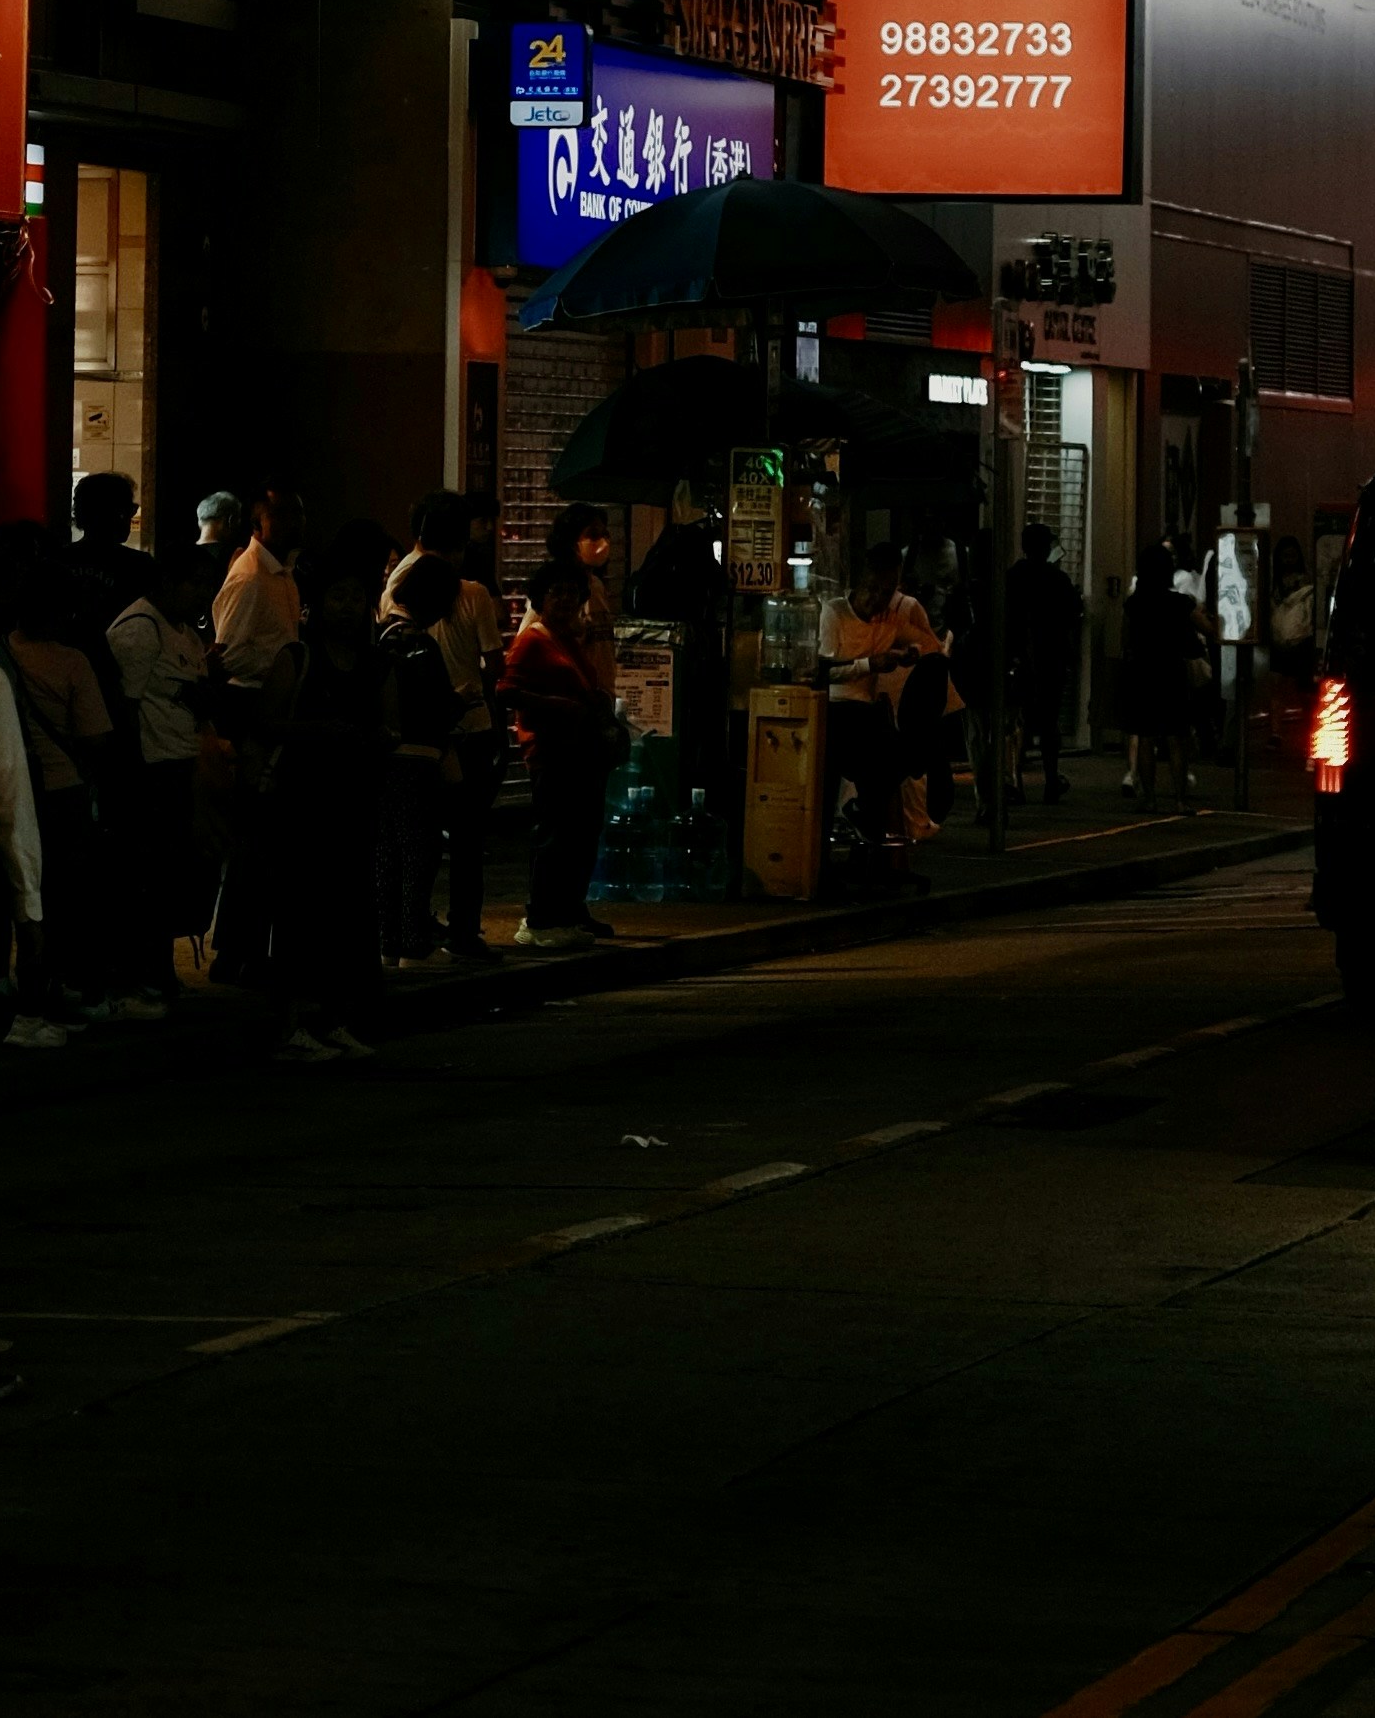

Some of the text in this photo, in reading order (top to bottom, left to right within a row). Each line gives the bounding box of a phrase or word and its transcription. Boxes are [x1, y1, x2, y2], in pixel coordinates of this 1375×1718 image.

[529, 34, 567, 69] 24
[879, 22, 1073, 57] 98832733
[879, 74, 1073, 110] 27392777
[588, 94, 694, 196] 交通銀行
[579, 190, 607, 220] BANK
[609, 194, 623, 222] OF
[729, 562, 774, 586] $12.30
